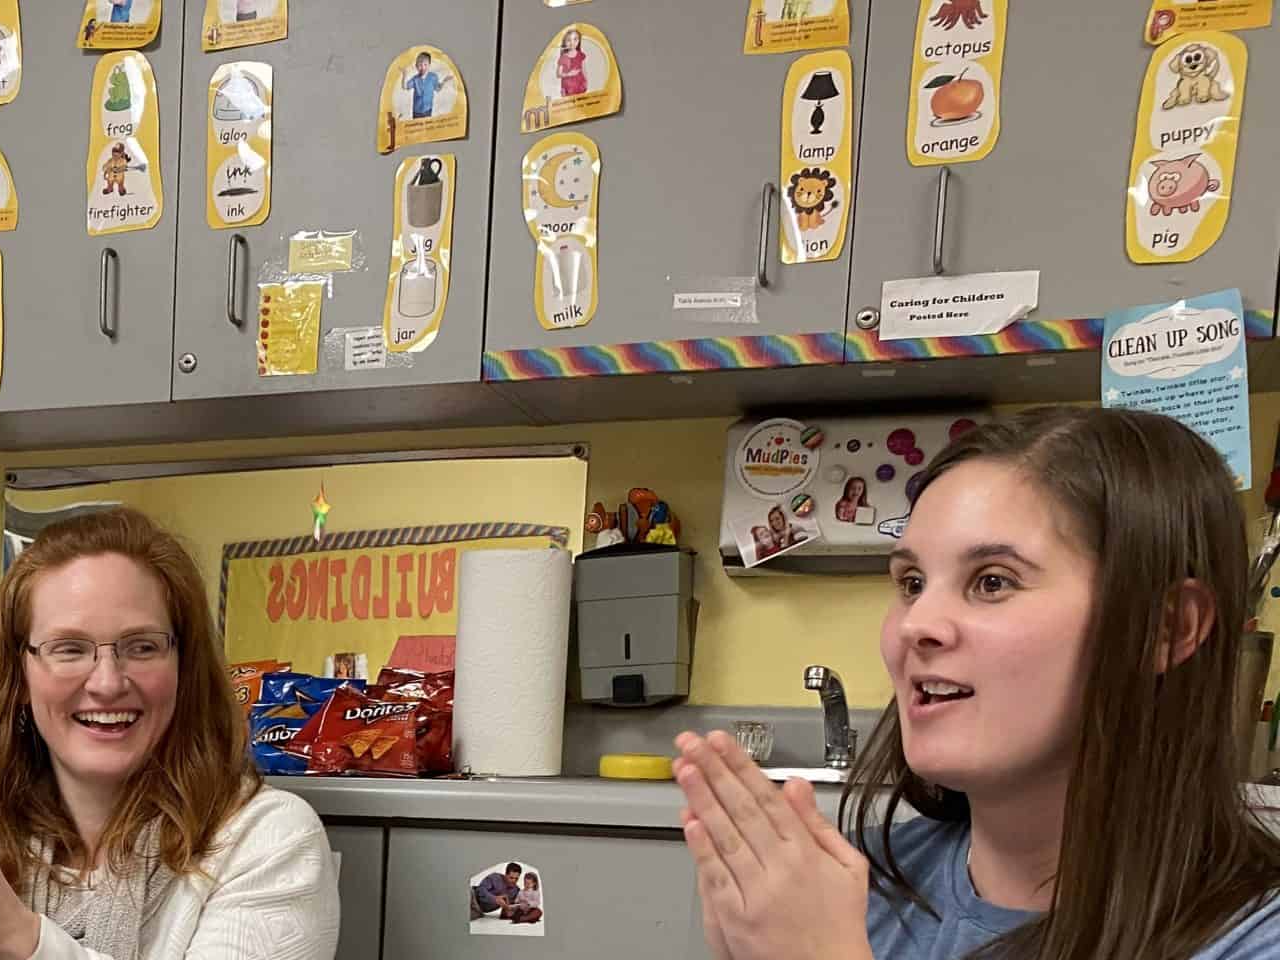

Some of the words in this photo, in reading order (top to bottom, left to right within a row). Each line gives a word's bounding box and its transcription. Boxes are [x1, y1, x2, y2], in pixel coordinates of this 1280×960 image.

[924, 40, 991, 58] octopus
[107, 123, 133, 136] frog
[219, 128, 248, 143] igloo
[1160, 122, 1215, 148] puppy
[799, 144, 835, 160] lamp
[921, 134, 980, 154] orange
[88, 206, 154, 221] firefighter
[227, 203, 245, 217] ink
[1152, 229, 1179, 248] pig
[889, 298, 929, 309] Caring
[932, 296, 949, 305] for
[952, 293, 1005, 303] Children
[553, 305, 584, 324] milk
[909, 312, 944, 321] Posted
[946, 311, 969, 319] Here
[394, 327, 415, 344] jar
[1108, 333, 1157, 359] CLEAN
[1167, 329, 1188, 348] UP
[1196, 318, 1240, 343] SONG
[746, 448, 808, 465] MudPies
[345, 703, 419, 720] Doritos
